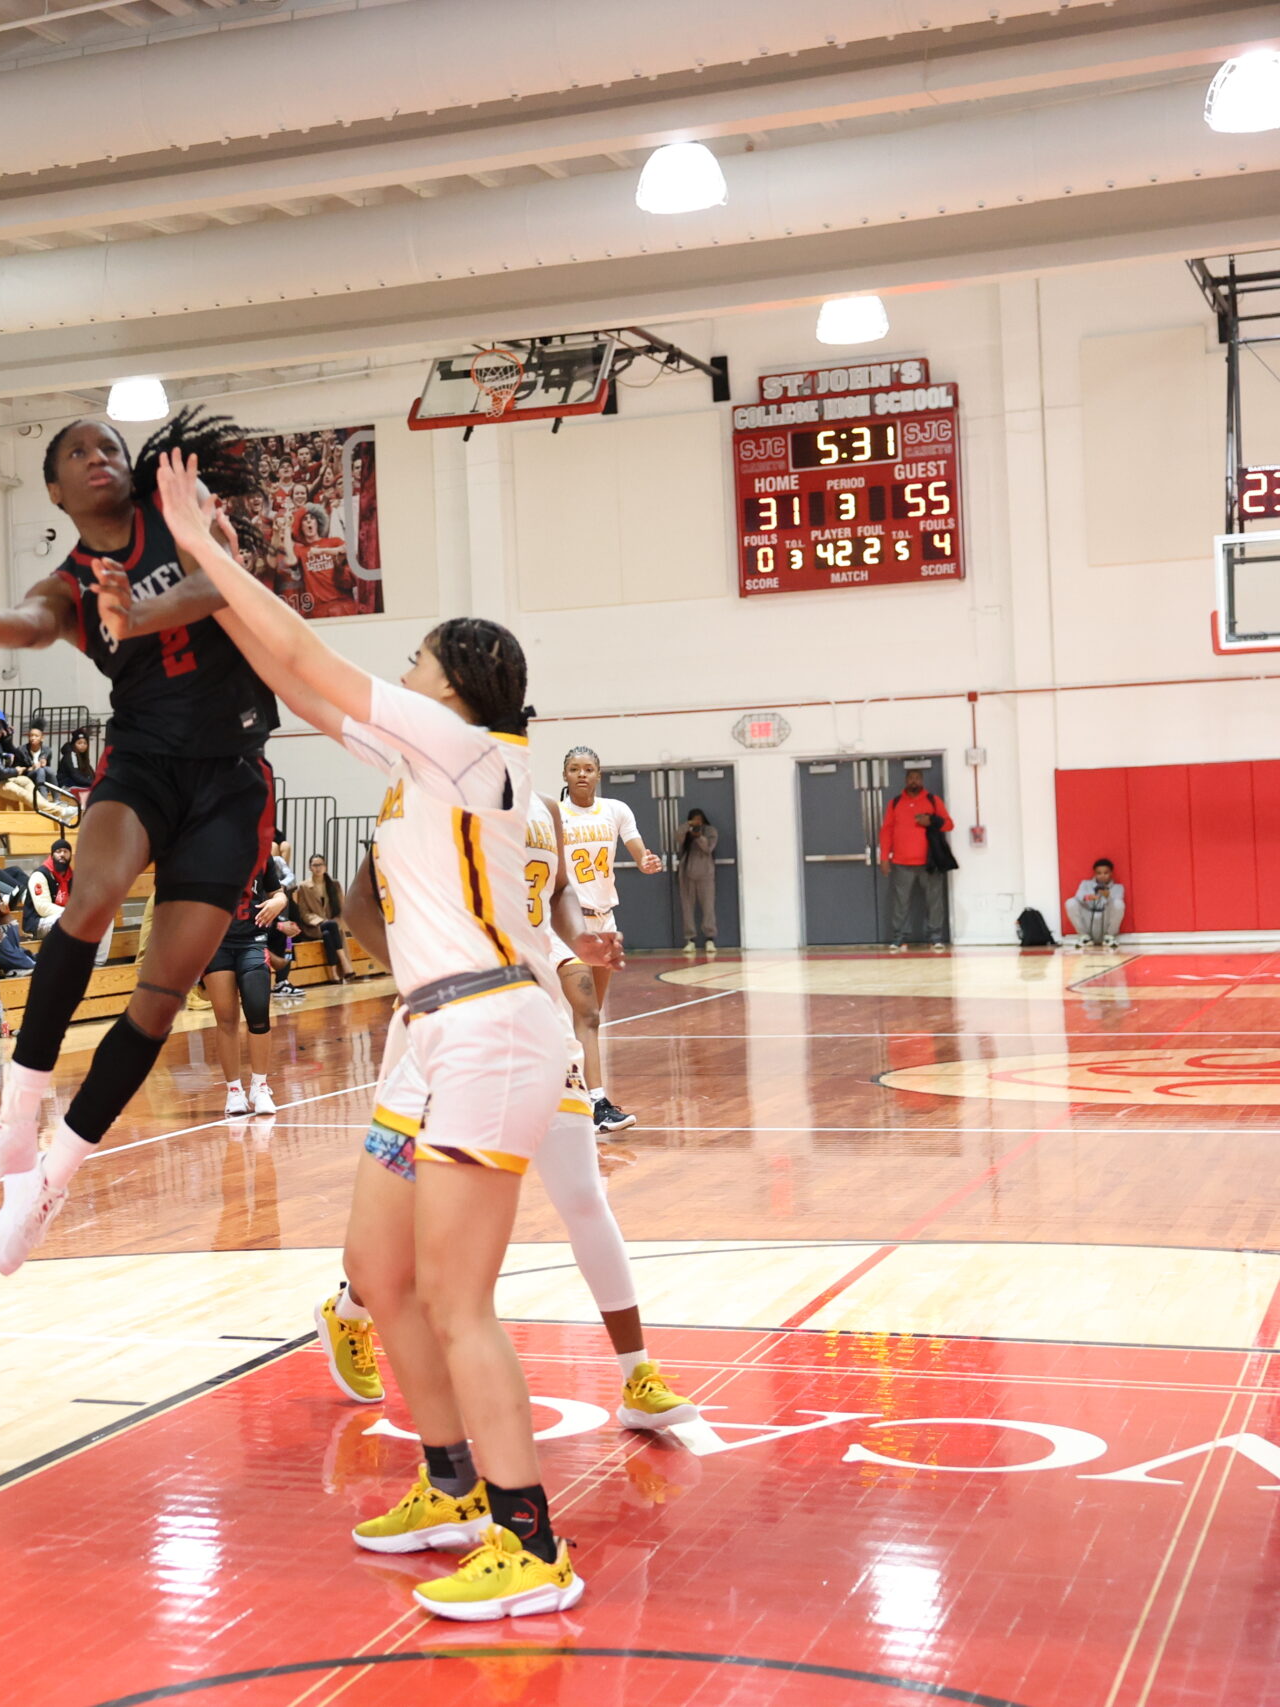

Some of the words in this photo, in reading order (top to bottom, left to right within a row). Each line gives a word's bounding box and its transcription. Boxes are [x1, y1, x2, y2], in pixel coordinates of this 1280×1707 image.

[762, 374, 811, 399] ST.
[817, 361, 921, 394] JOHN'S
[734, 400, 819, 429] COLLEGE
[874, 386, 953, 415] SCHOOL
[903, 419, 952, 444] SJC
[740, 437, 786, 460] SJC
[817, 426, 895, 464] 5:31
[894, 461, 947, 480] GUEST
[755, 475, 800, 493] HOME
[826, 477, 865, 491] PERIOD
[839, 493, 856, 520] 3
[904, 481, 950, 517] 55
[758, 496, 800, 531] 31
[919, 518, 955, 531] FOULS
[744, 533, 778, 547] FOULS
[811, 527, 852, 540] PLAYER
[857, 524, 885, 537] FOUL
[933, 533, 951, 556] 4
[757, 547, 774, 573] 0
[790, 549, 803, 569] 3
[921, 563, 956, 576] SCORE
[745, 577, 779, 590] SCORE
[831, 571, 868, 584] MATCH
[160, 624, 198, 678] 2
[571, 846, 609, 884] 24
